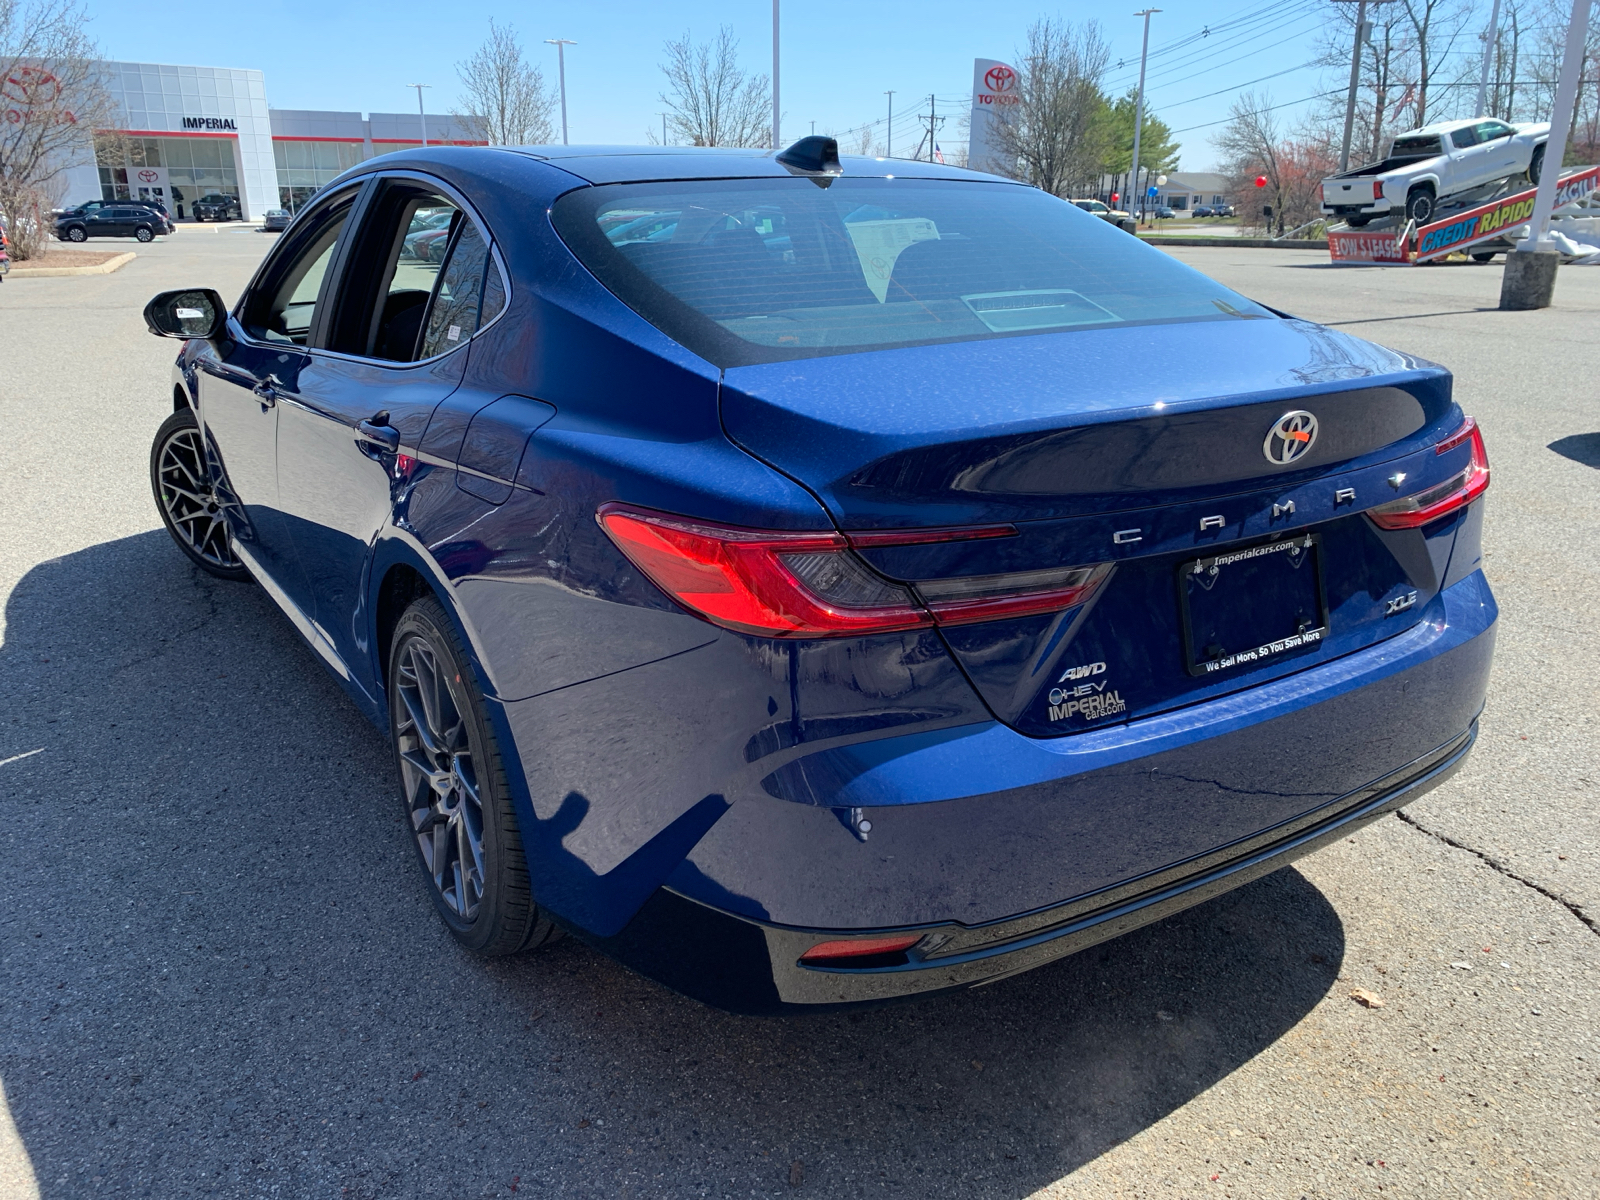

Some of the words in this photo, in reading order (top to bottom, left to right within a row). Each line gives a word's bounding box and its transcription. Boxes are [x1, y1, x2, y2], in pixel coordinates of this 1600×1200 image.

[0, 108, 77, 124] OYA
[182, 117, 238, 130] IMPERIAL
[1421, 217, 1479, 253] CREDIT
[1479, 197, 1535, 234] RÁPIDO
[1333, 238, 1358, 256] LOW
[1214, 541, 1294, 566] Imperialcars.com
[1386, 590, 1418, 614] XLE
[1206, 662, 1220, 672] We
[1220, 657, 1236, 669] Sell
[1236, 651, 1258, 663] More,
[1258, 646, 1269, 657] So
[1270, 642, 1284, 653] You
[1284, 638, 1302, 649] Save
[1302, 632, 1320, 644] More
[1057, 661, 1107, 683] AWD
[1048, 690, 1125, 722] IMPERIAL
[1085, 702, 1126, 721] cars.com
